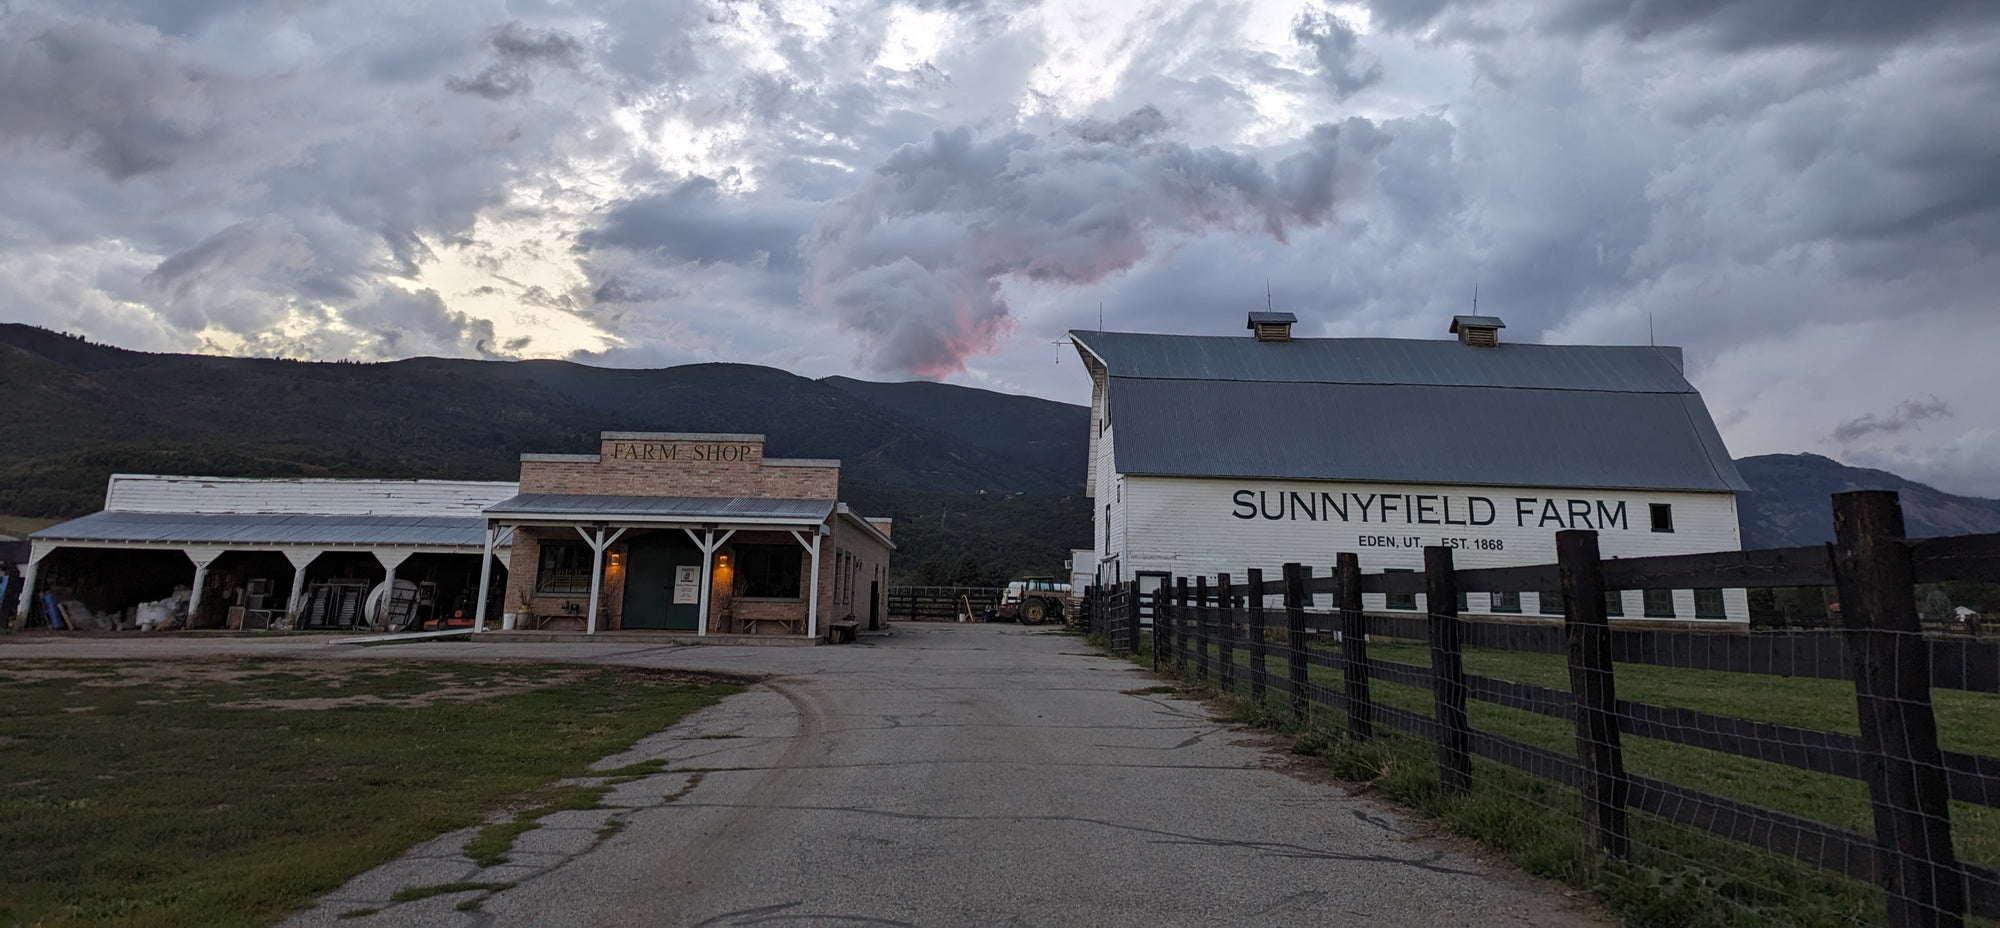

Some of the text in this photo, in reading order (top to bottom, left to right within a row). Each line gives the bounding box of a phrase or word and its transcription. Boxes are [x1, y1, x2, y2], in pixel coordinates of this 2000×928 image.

[613, 442, 752, 462] FARM SHOP
[1231, 489, 1629, 530] SUNNYFIELD FARM
[1358, 535, 1504, 551] EDEN, UT. EST. 1868
